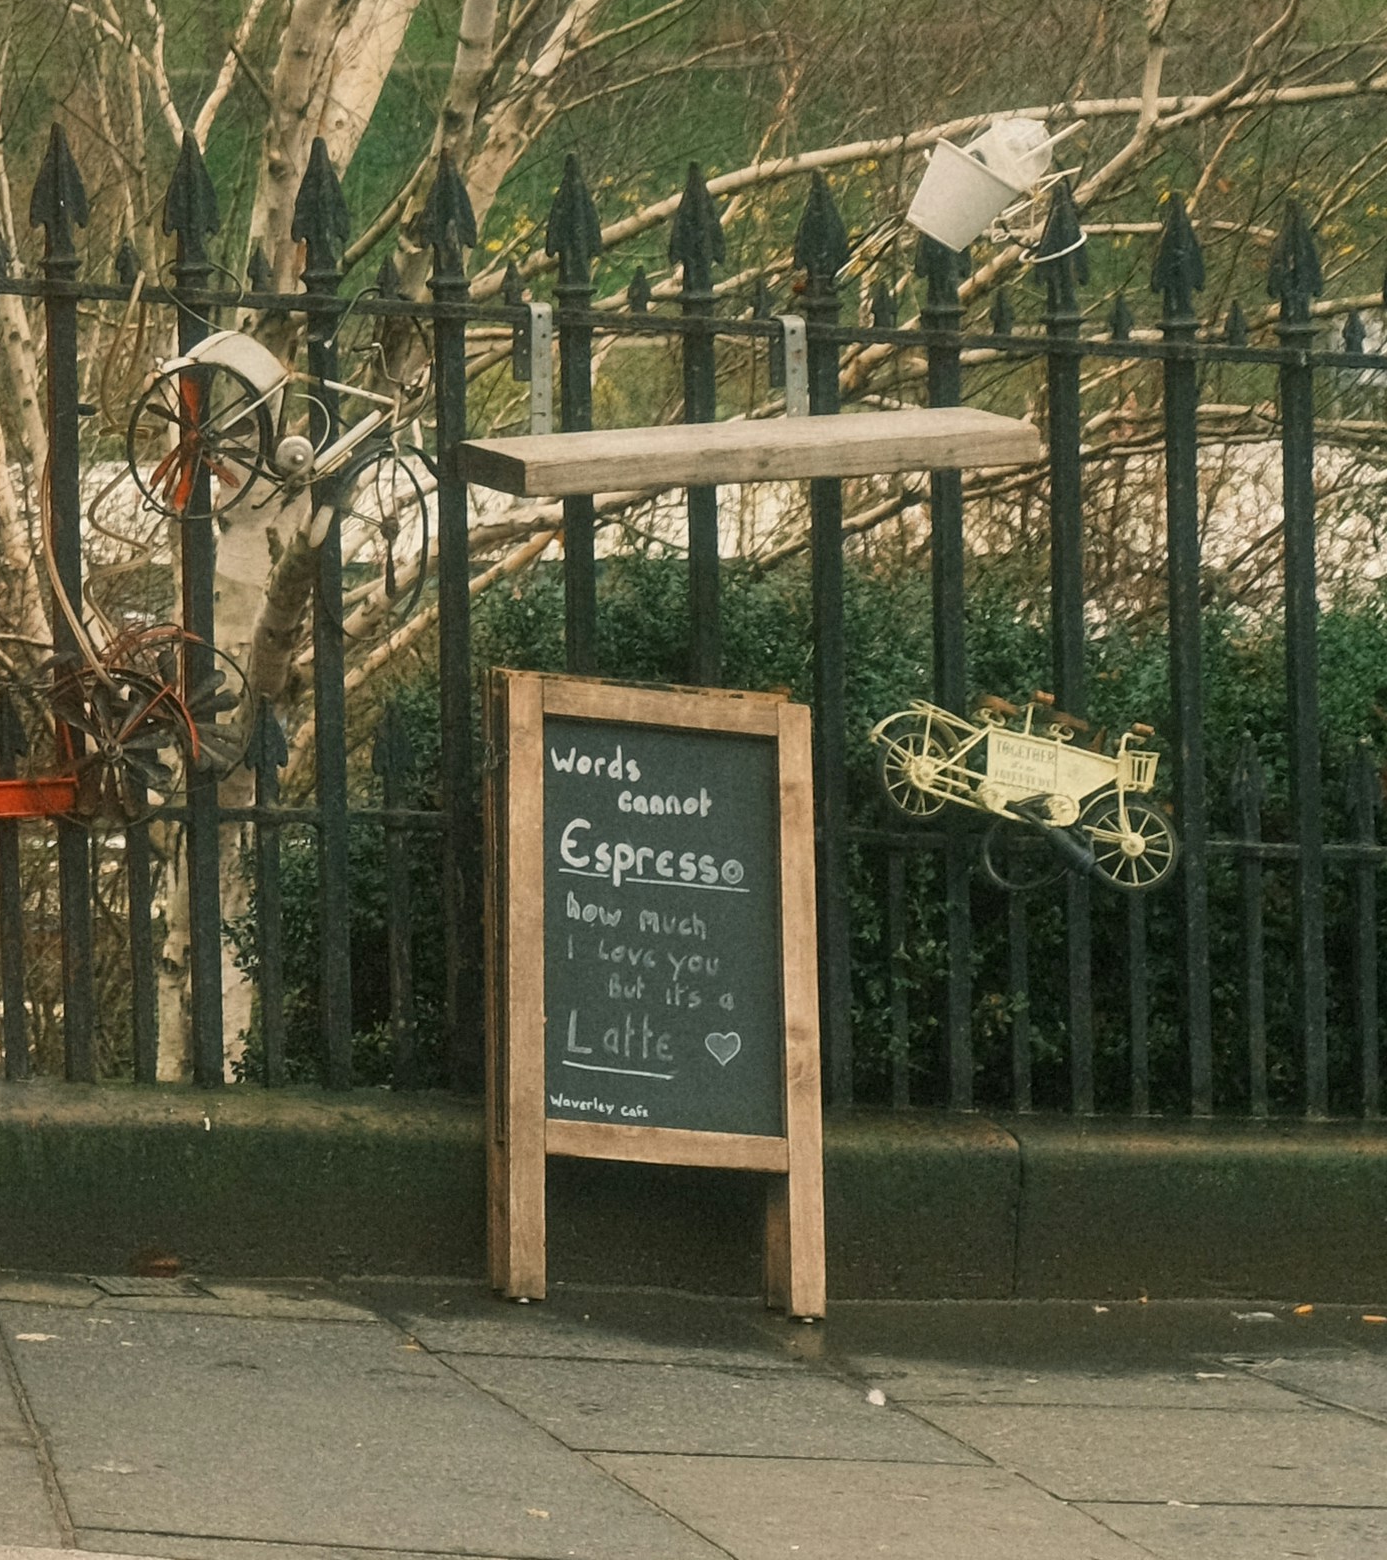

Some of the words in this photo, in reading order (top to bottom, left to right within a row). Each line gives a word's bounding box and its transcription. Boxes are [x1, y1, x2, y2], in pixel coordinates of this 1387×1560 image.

[550, 745, 641, 782] Words
[618, 787, 712, 817] cannot
[560, 818, 745, 887] Espresso
[566, 890, 622, 924] how
[567, 934, 573, 960] I
[669, 951, 719, 982] you
[719, 992, 735, 1010] a
[566, 1009, 674, 1062] Latte
[550, 1094, 614, 1115] Waverley
